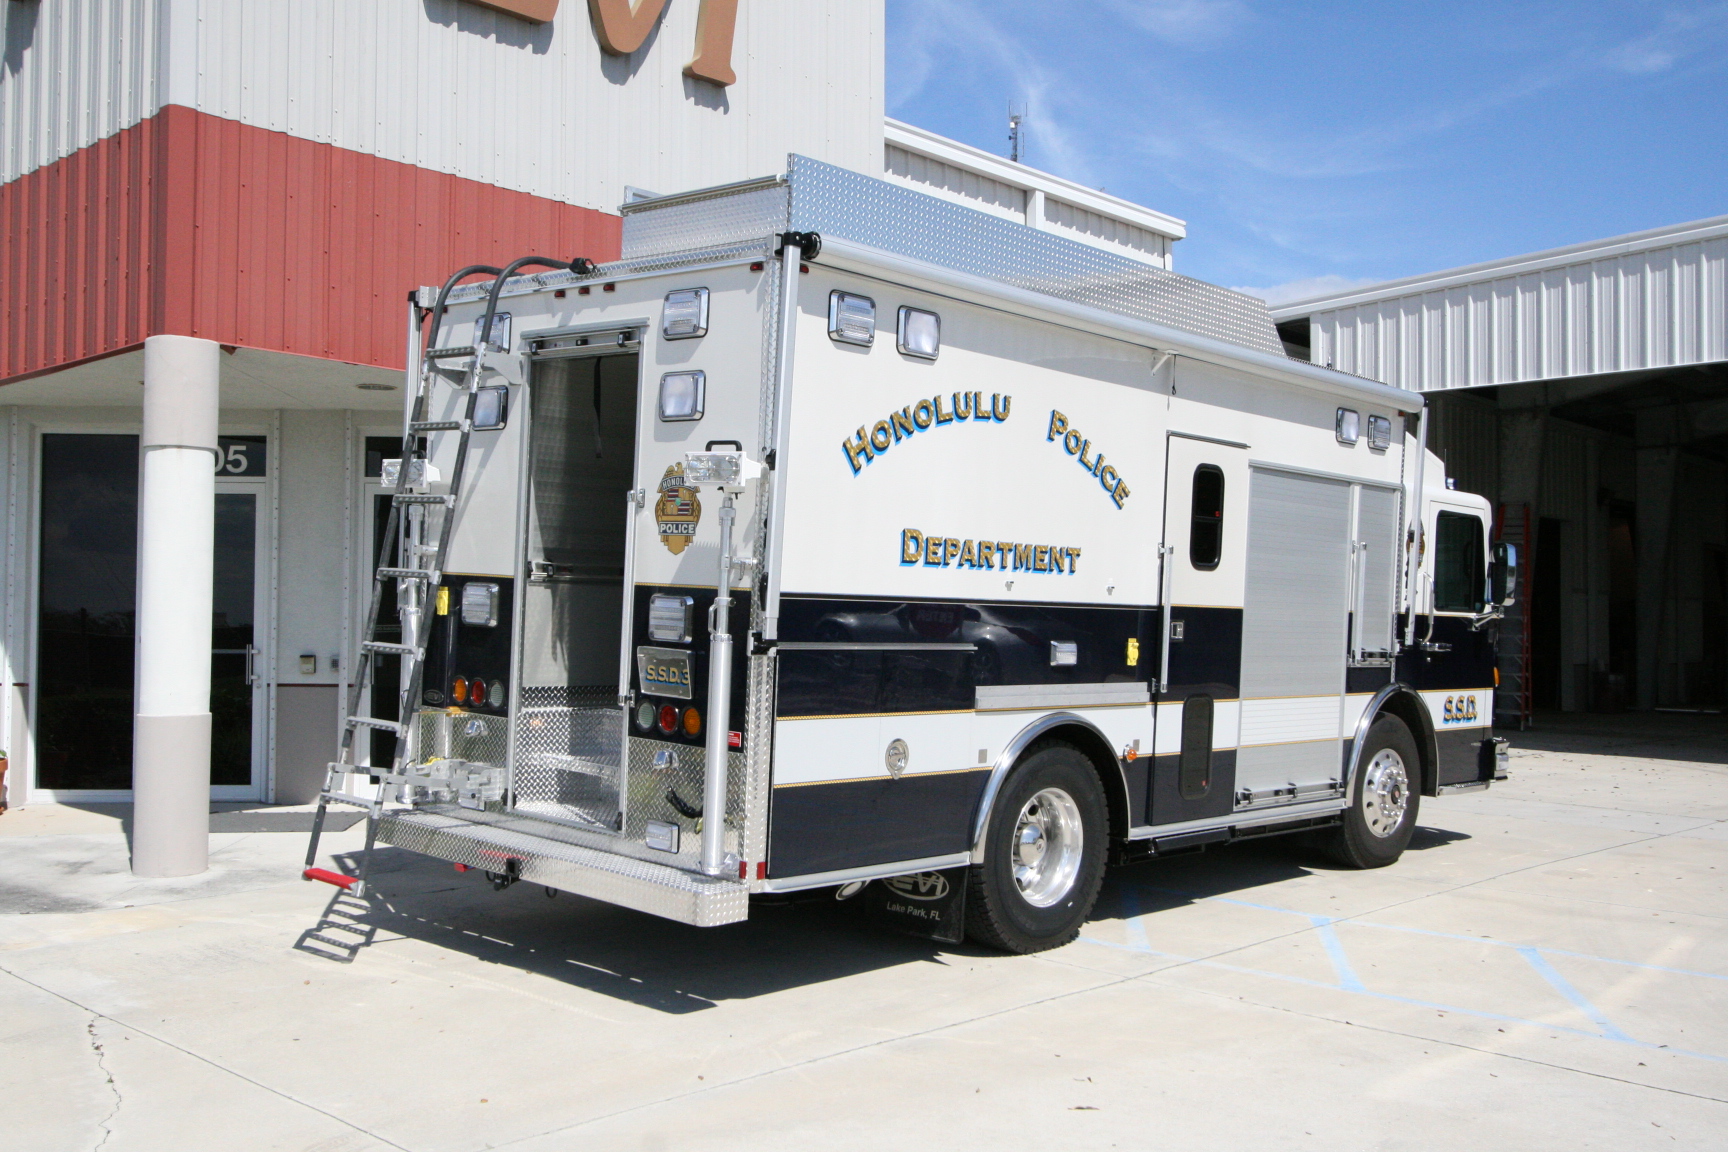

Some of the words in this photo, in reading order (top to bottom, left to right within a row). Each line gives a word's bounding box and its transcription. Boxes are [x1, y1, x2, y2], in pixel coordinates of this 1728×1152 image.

[842, 391, 1012, 478] HONOLULU
[1046, 409, 1131, 510] POLICE
[661, 476, 695, 491] HONOL
[660, 523, 695, 534] POLICE
[899, 528, 1082, 576] DEPARTMENT
[886, 901, 905, 913] Lake
[907, 905, 927, 919] Park,
[929, 910, 941, 921] FL
